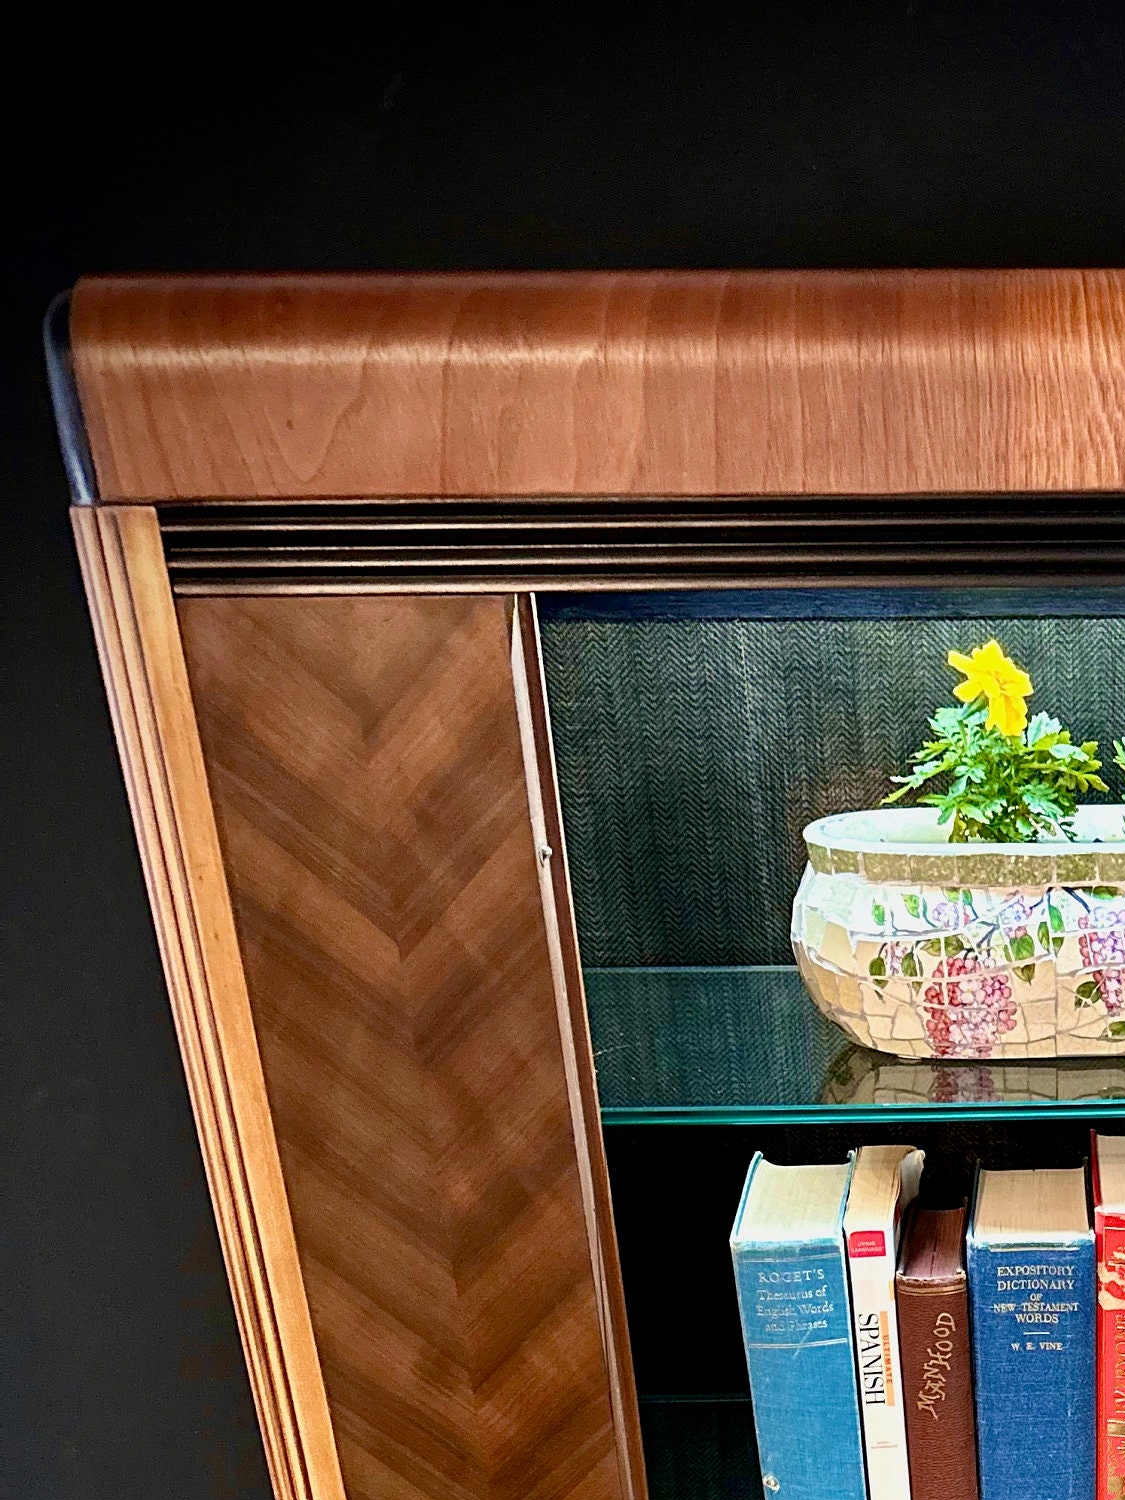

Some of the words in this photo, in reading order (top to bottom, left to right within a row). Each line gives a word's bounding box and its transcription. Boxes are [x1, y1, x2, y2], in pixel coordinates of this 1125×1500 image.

[758, 1269, 825, 1283] ROGET'S
[997, 1265, 1074, 1277] EXPOSITORY
[997, 1279, 1074, 1291] DICTIONARY
[756, 1289, 814, 1301] Thesaurus
[815, 1285, 828, 1297] of
[755, 1304, 797, 1320] English
[797, 1301, 834, 1314] Words
[993, 1303, 1016, 1313] NEW
[1022, 1302, 1079, 1312] TESTAMENT
[1015, 1313, 1059, 1323] WORDS
[765, 1322, 785, 1332] and
[787, 1320, 828, 1331] Phrases
[1039, 1342, 1063, 1351] VINE
[858, 1313, 886, 1406] SPANISH
[882, 1335, 893, 1384] ULTIMATE
[917, 1312, 956, 1421] MANHOOD
